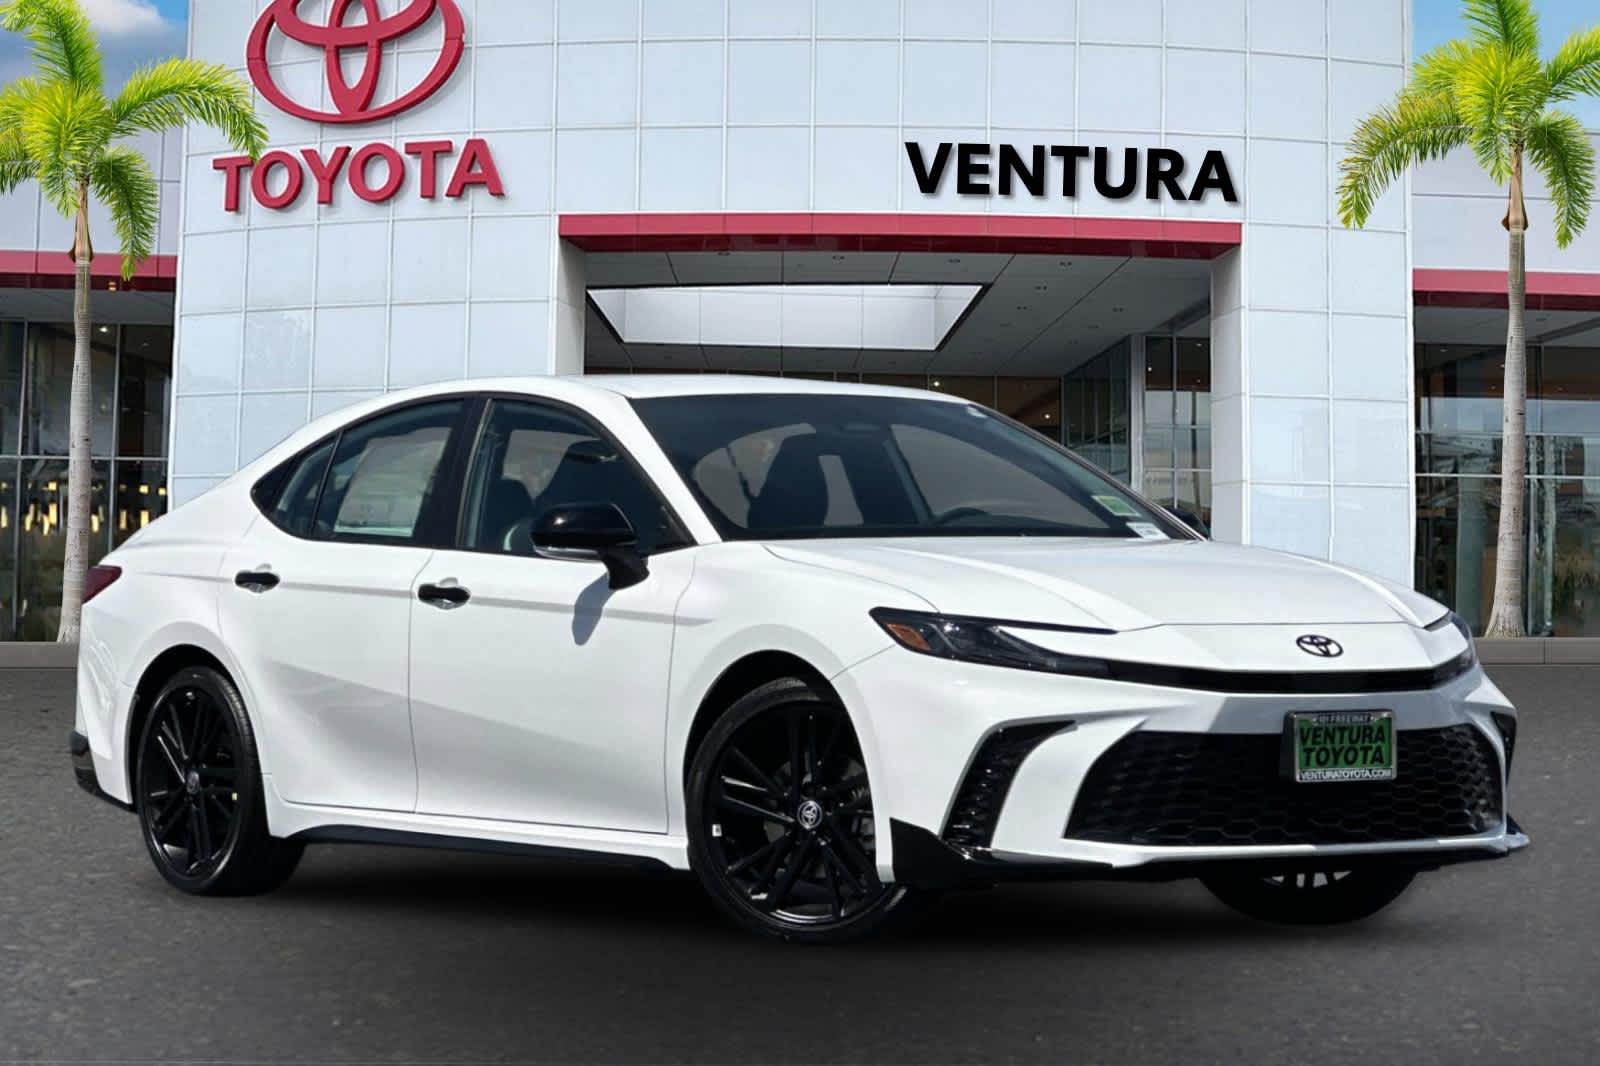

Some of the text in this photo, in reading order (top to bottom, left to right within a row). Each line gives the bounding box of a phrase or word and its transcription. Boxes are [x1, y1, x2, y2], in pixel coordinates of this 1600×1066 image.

[213, 138, 505, 212] TOYOTA
[904, 142, 1239, 203] VENTURA
[1300, 726, 1385, 745] VENTURA
[1303, 746, 1384, 766] TOYOTA
[1301, 769, 1392, 780] VENTURATOYOTA.COM
